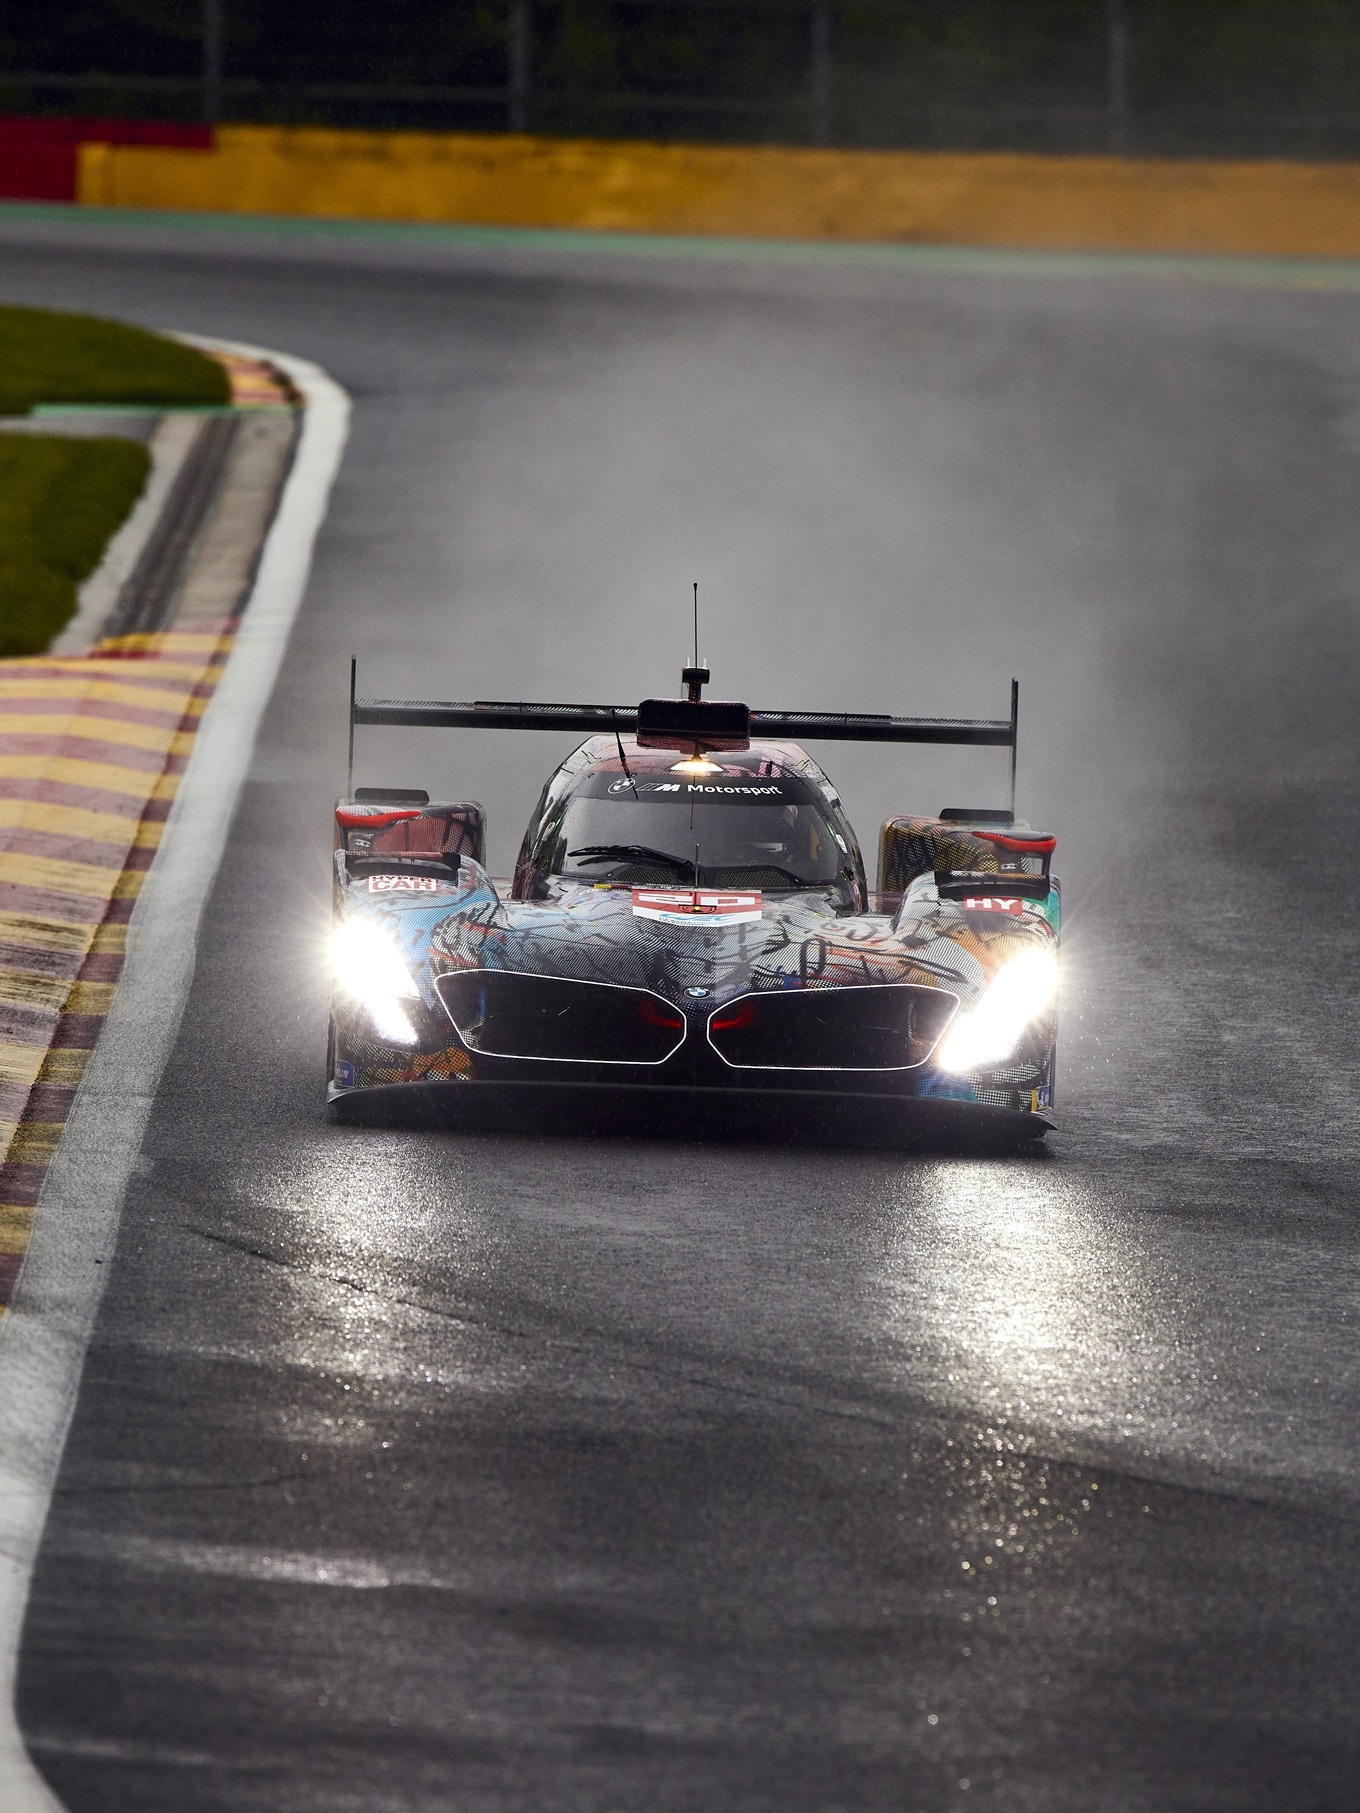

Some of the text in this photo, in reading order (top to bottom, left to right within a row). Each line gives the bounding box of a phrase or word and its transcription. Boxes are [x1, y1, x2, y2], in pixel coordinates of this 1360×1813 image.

[687, 784, 783, 796] Motorsport
[372, 881, 432, 890] CAR
[966, 898, 1018, 910] HY
